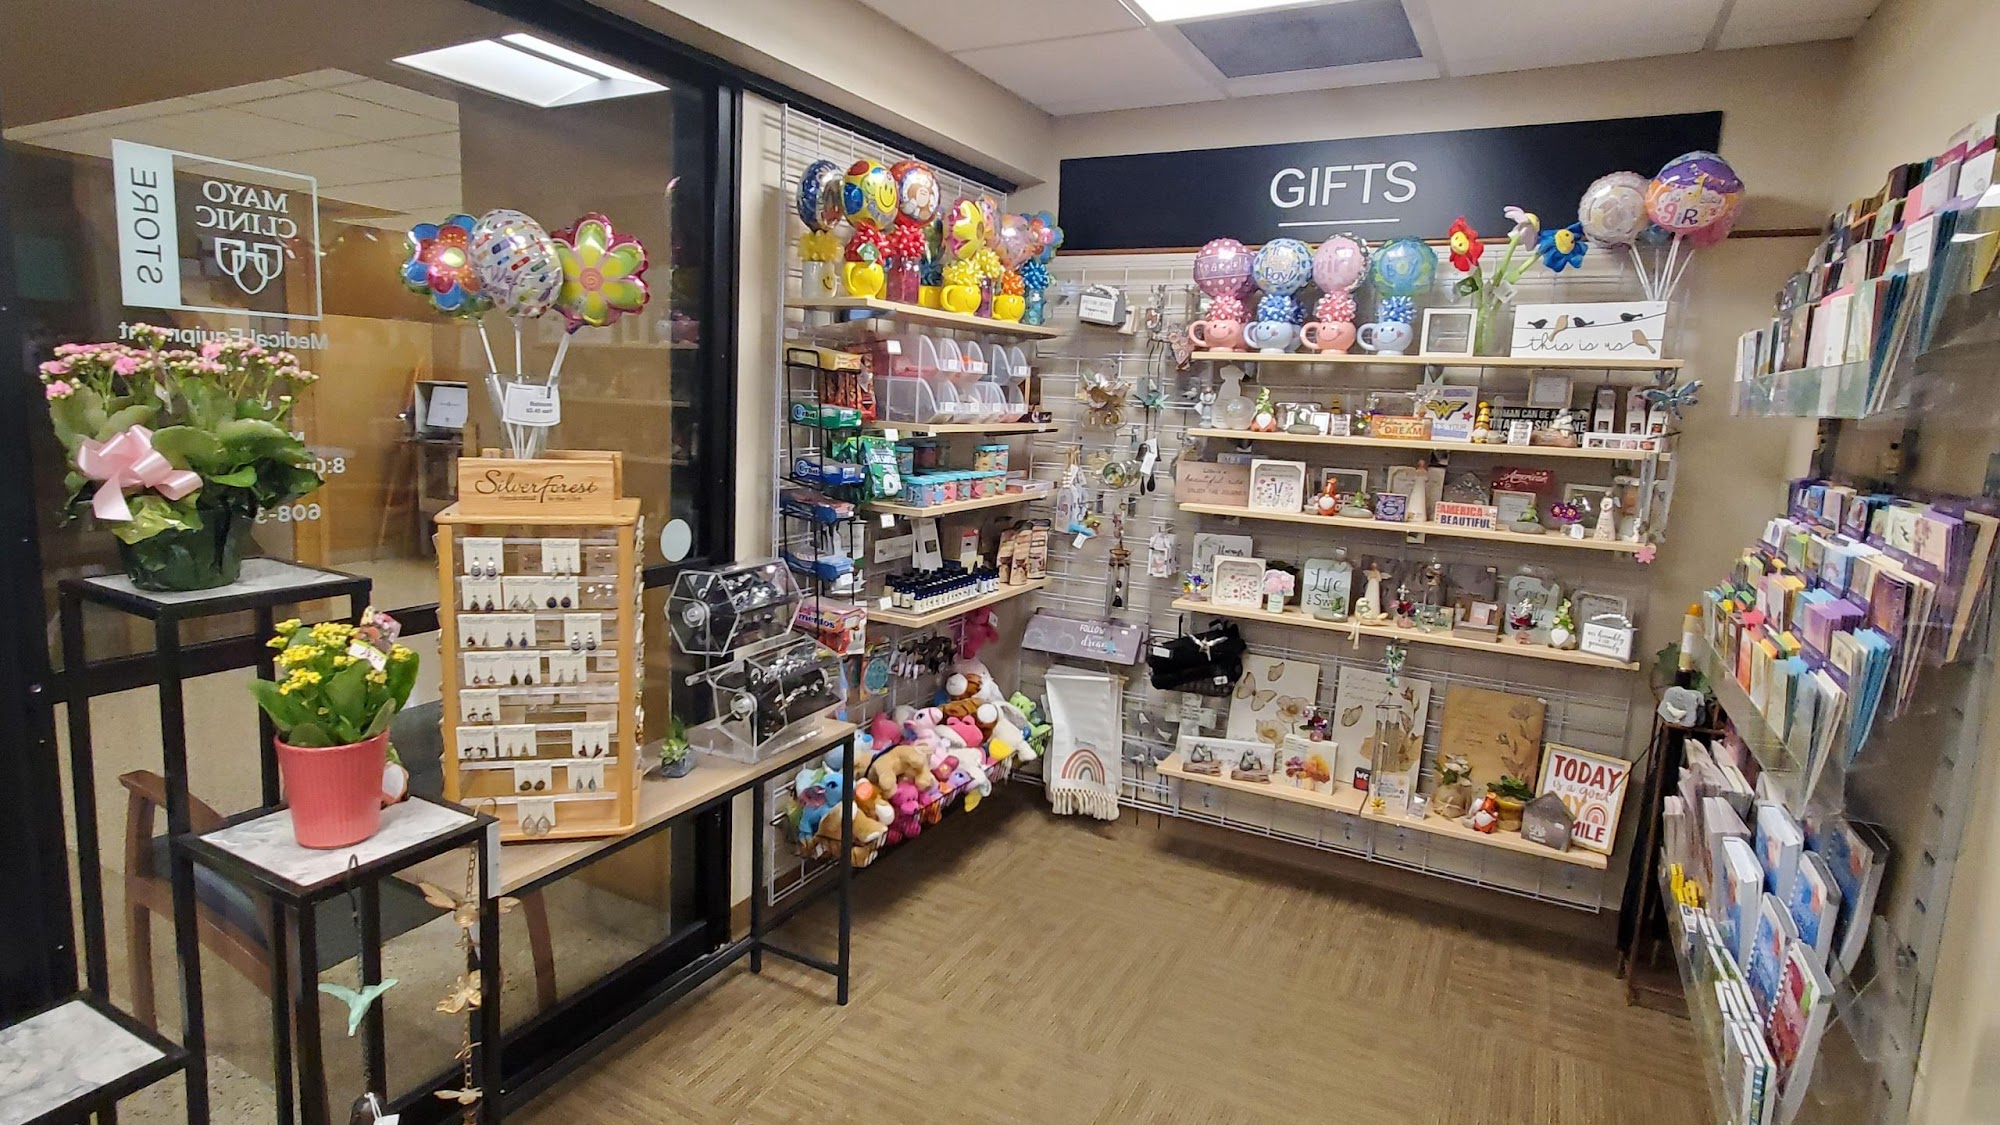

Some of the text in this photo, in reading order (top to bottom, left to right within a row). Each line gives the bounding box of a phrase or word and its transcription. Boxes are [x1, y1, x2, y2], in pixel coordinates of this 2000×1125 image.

[1270, 161, 1418, 208] GIFTS
[1529, 331, 1626, 351] this is us
[1521, 409, 1537, 419] CAN
[1440, 504, 1483, 517] AMERICA
[1440, 515, 1491, 529] BEAUTIFUL
[1080, 624, 1106, 635] FOLLOW
[1554, 754, 1622, 793] TODAY
[1572, 821, 1607, 843] MILE
